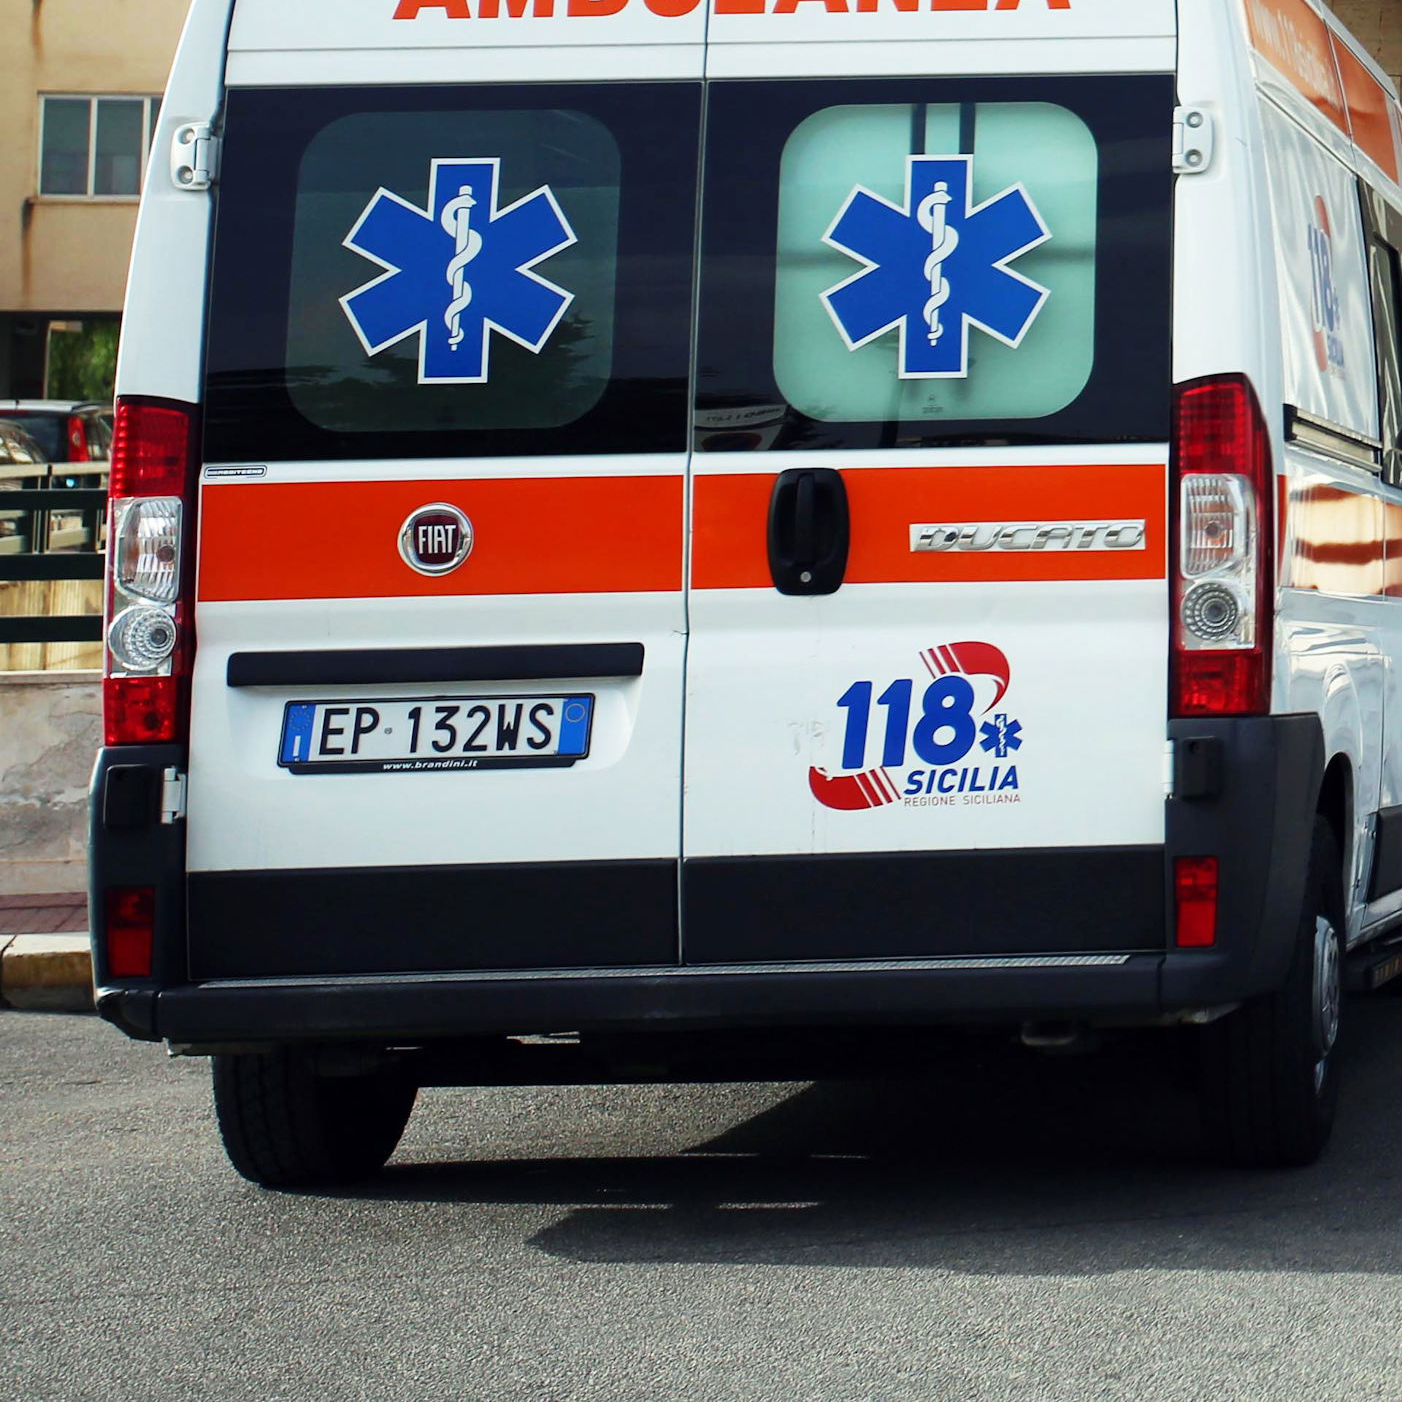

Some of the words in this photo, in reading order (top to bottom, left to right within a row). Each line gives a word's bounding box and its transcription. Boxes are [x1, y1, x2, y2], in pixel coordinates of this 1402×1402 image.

[418, 524, 457, 554] FIAT
[914, 523, 1145, 552] DUCATO
[319, 707, 380, 755] EP
[407, 702, 555, 754] 132WS
[836, 675, 977, 769] 118
[382, 759, 478, 771] www.brandini.it
[903, 765, 1019, 796] SICILIA
[904, 796, 956, 807] REGIONE
[963, 793, 1021, 805] SICILIANA
